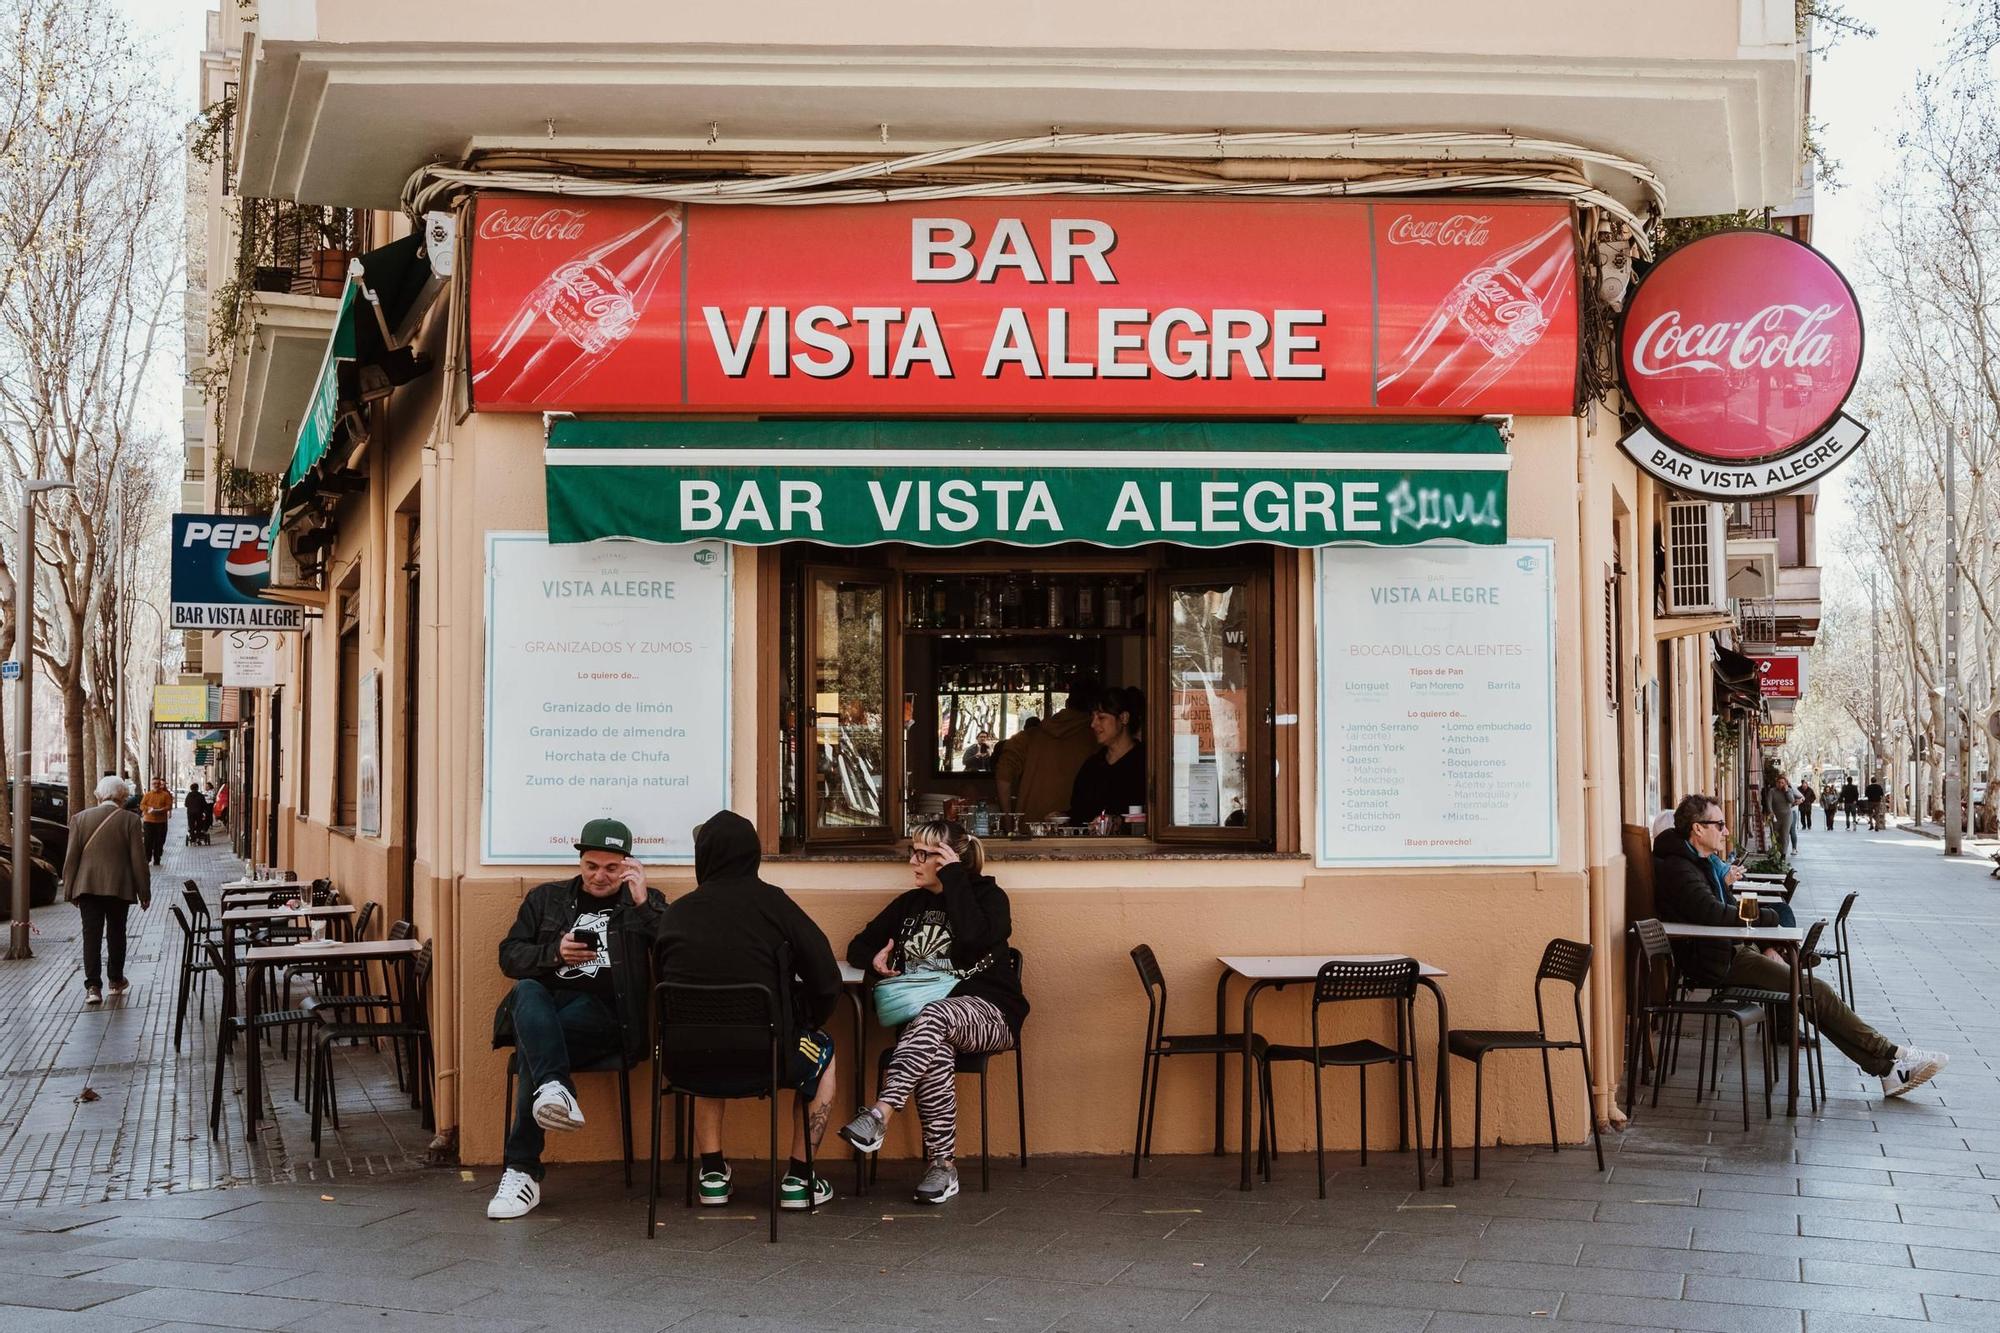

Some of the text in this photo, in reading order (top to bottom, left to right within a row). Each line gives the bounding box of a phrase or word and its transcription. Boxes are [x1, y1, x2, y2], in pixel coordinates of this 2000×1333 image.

[480, 208, 592, 240] Coca-Cola
[1388, 214, 1494, 247] Coca-Cola
[911, 217, 1119, 285] BAR
[702, 306, 1326, 381] VISTA ALEGRE
[1633, 303, 1844, 376] Coca-Cola
[1650, 436, 1843, 488] BAR VISTA ALEGRE
[679, 480, 1381, 532] BAR VISTA ALEGRE
[542, 580, 675, 599] VISTA ALEGRE
[1371, 586, 1499, 605] VISTA ALEGRE
[176, 606, 300, 627] BAR VISTA ALEGRE
[524, 641, 693, 654] GRANIZADOS Y ZUMOS
[1350, 644, 1522, 656] BOCADILLOS CALIENTES
[577, 671, 588, 680] Lo
[591, 671, 618, 682] quiero
[1410, 668, 1464, 677] Tipos de Pan
[1345, 681, 1521, 691] Llonguet Pan Moreno Barrita
[1761, 677, 1794, 687] Express
[542, 702, 673, 714] Granizado de limón
[1408, 710, 1418, 718] Lo
[1420, 710, 1447, 720] quiero
[529, 726, 686, 738] Granizado de almendra
[1346, 722, 1419, 732] Jamón Serrano
[1447, 722, 1532, 732] Lomo embuchado
[1447, 734, 1489, 743] Anchoas
[1346, 742, 1405, 752] Jamón York
[1447, 746, 1471, 755] Atún
[545, 751, 670, 763] Horchata de Chufa
[1447, 758, 1506, 769] Boquerones
[525, 775, 689, 789] Zumo de naranja natural
[1353, 775, 1404, 785] Manchego
[1346, 787, 1399, 797] Sobrasada
[1346, 823, 1386, 832] Chorizo
[1431, 838, 1472, 848] provecho!
